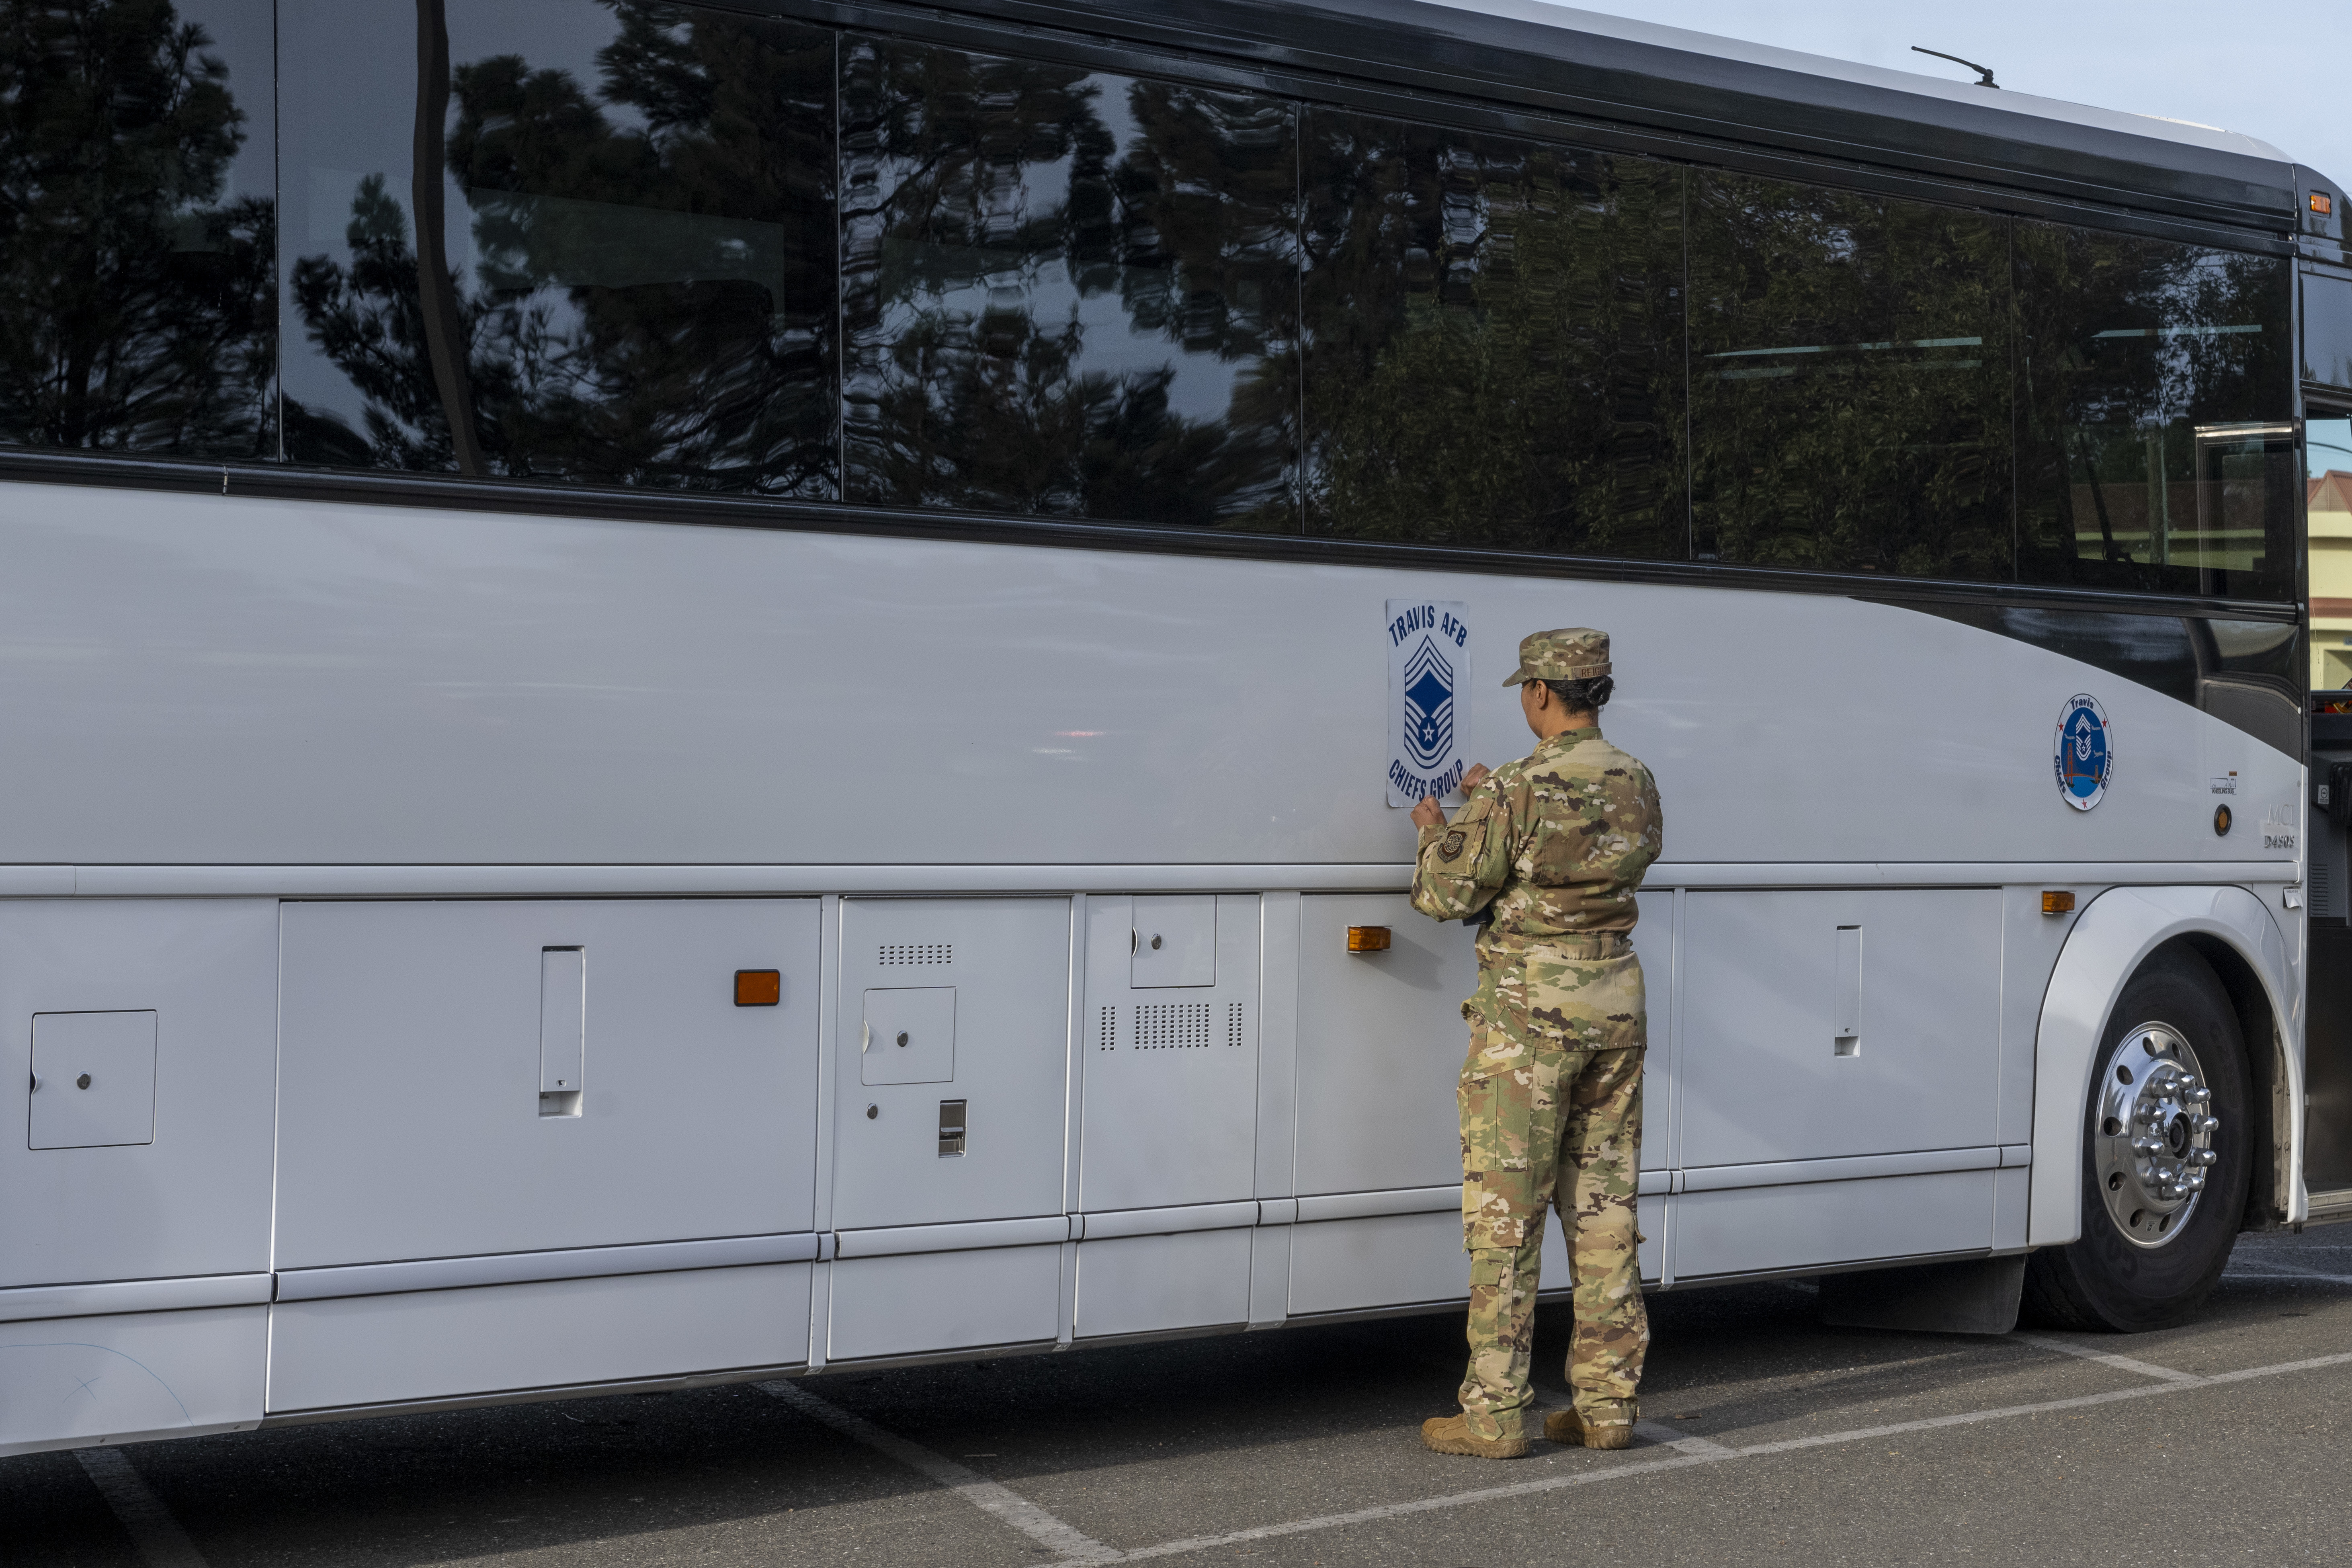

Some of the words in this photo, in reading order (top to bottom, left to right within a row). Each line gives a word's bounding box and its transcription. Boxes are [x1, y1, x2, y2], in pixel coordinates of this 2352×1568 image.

[1389, 605, 1435, 648] TRAVIS
[1440, 612, 1467, 648] AFB
[2070, 697, 2094, 711] Travis
[1389, 759, 1426, 802] CHIEFS
[1430, 758, 1463, 800] GROUP
[2055, 755, 2066, 794] Chiefs
[2100, 750, 2112, 790] Group
[2267, 804, 2294, 825] MCI
[2264, 835, 2295, 849] D4505
